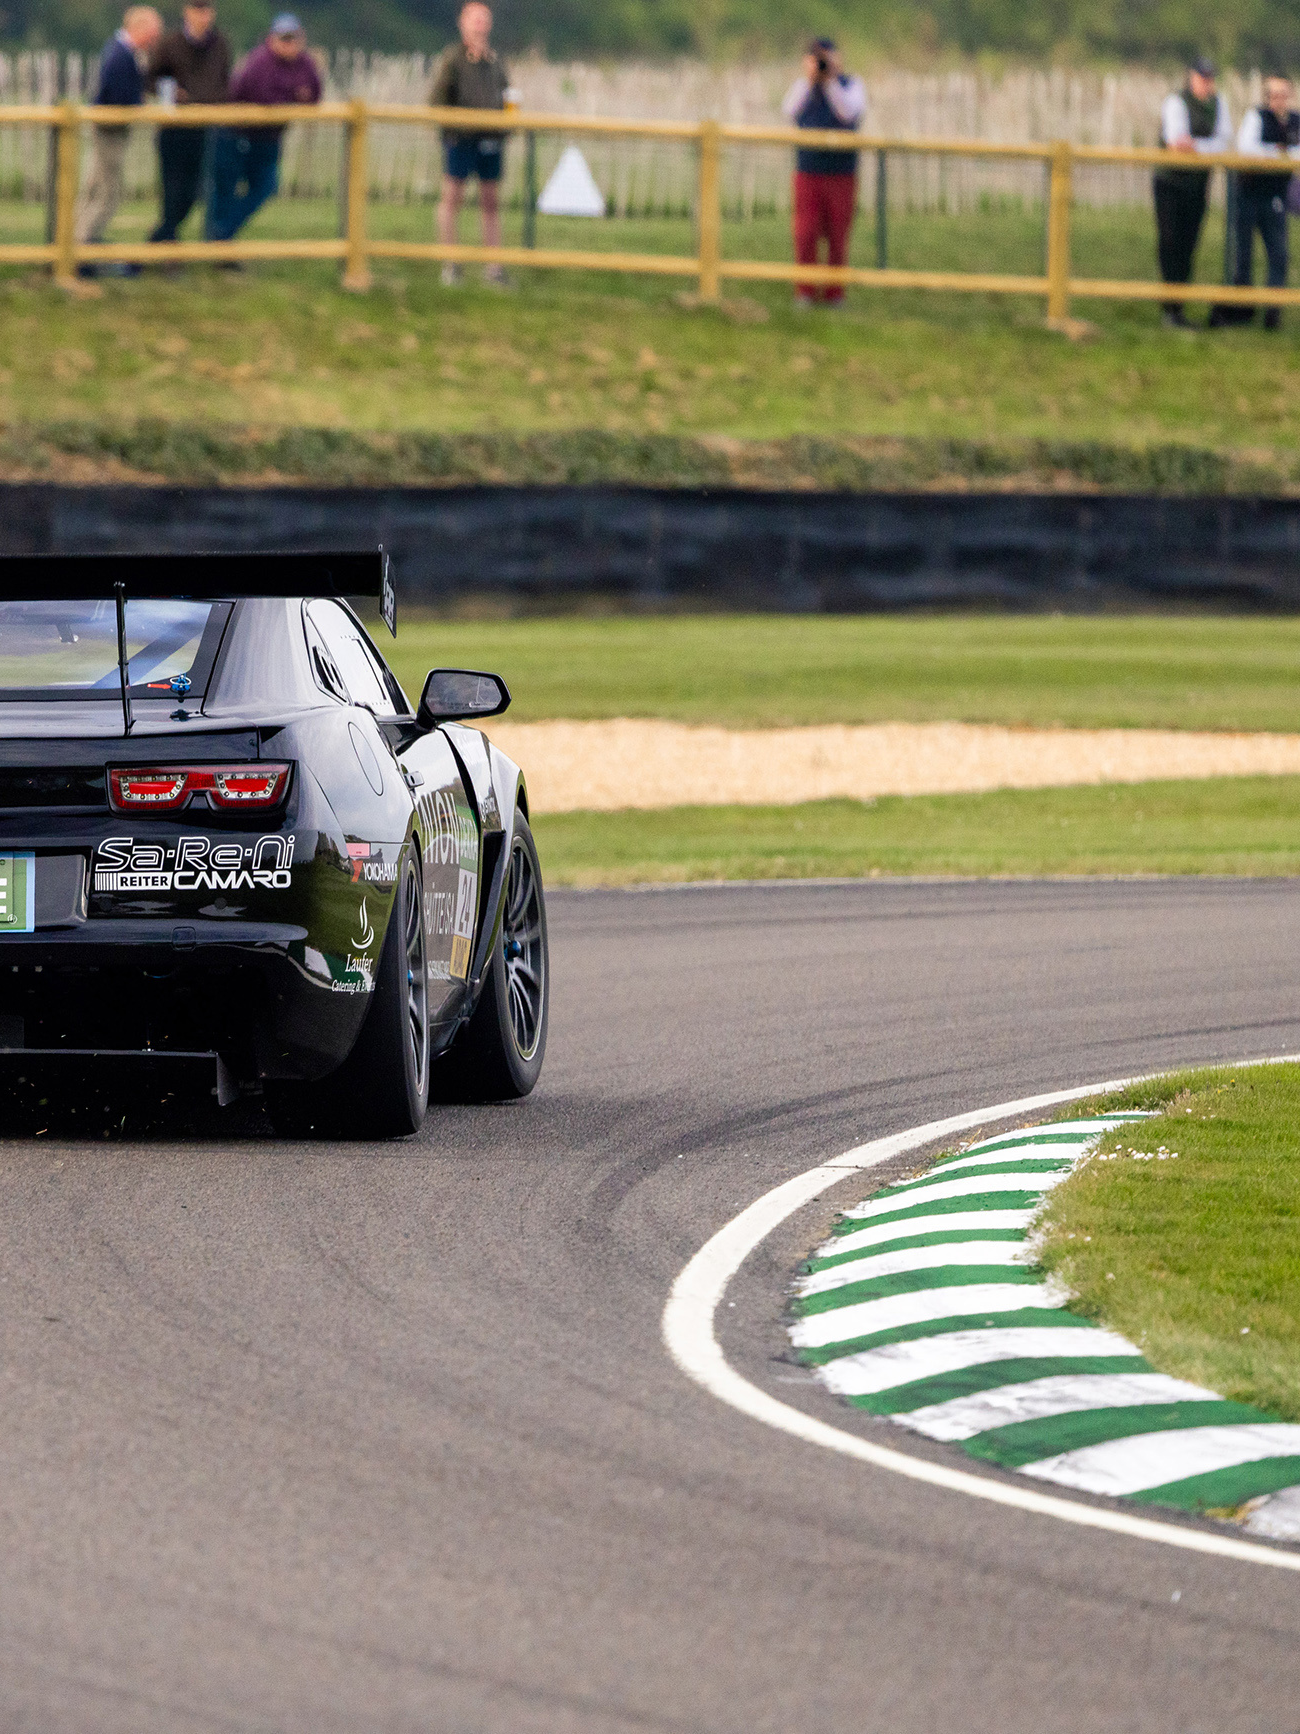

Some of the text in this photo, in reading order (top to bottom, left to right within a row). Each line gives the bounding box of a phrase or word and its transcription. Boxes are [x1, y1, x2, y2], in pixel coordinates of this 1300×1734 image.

[120, 870, 292, 890] REITER CAMARO
[362, 862, 398, 881] YOKOHAMA
[458, 874, 473, 934] 24
[345, 951, 374, 972] Laufer
[331, 979, 356, 995] Catering
